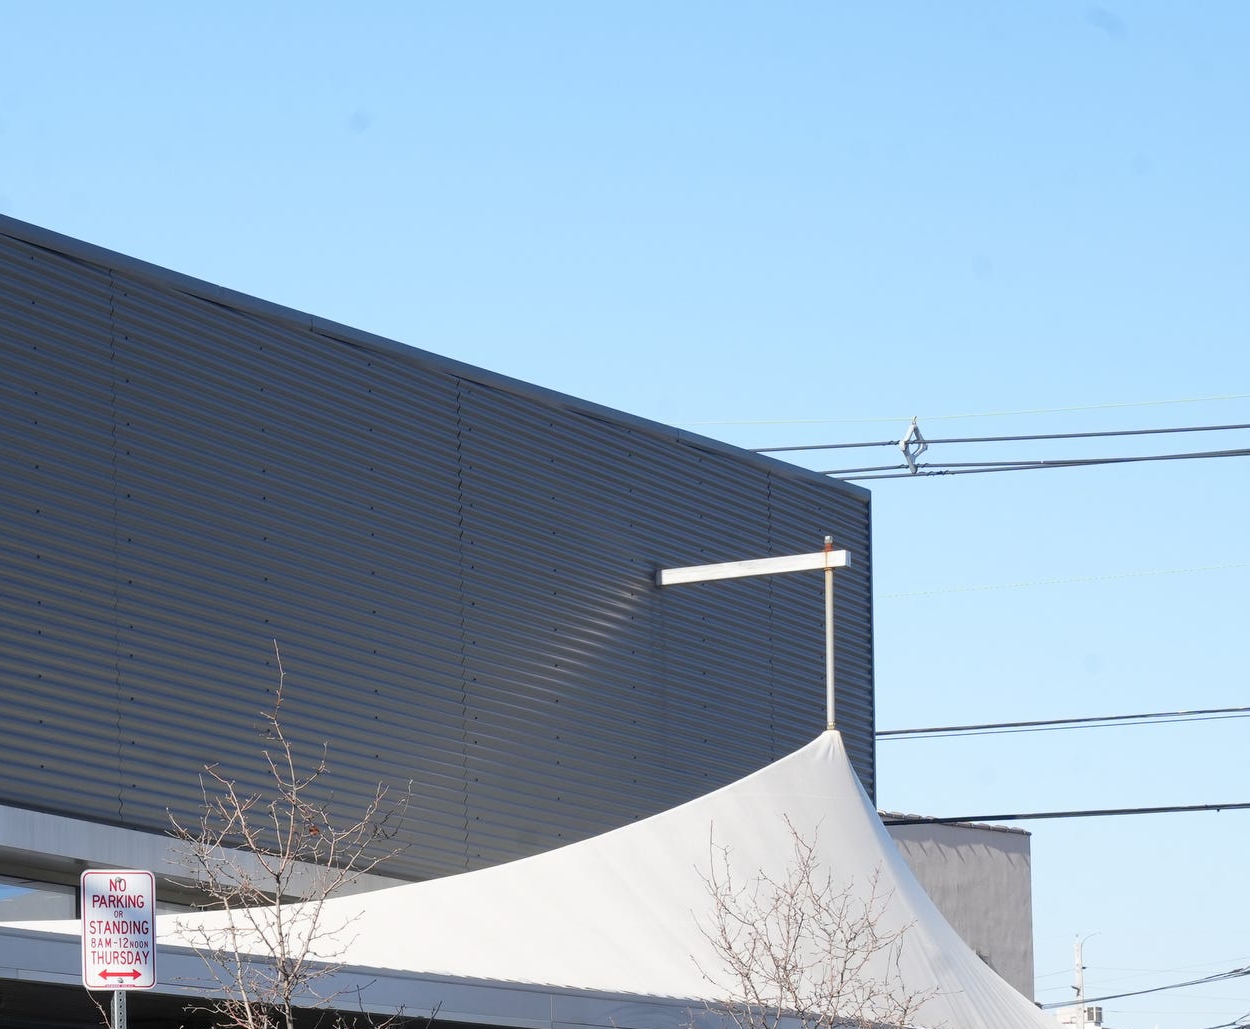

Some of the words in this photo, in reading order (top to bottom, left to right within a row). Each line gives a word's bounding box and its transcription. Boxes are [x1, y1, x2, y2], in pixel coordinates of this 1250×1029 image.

[109, 878, 127, 892] NO
[92, 894, 145, 909] PARKING
[113, 910, 124, 918] OR
[89, 920, 149, 934] STANDING
[90, 951, 150, 965] THURSDAY
